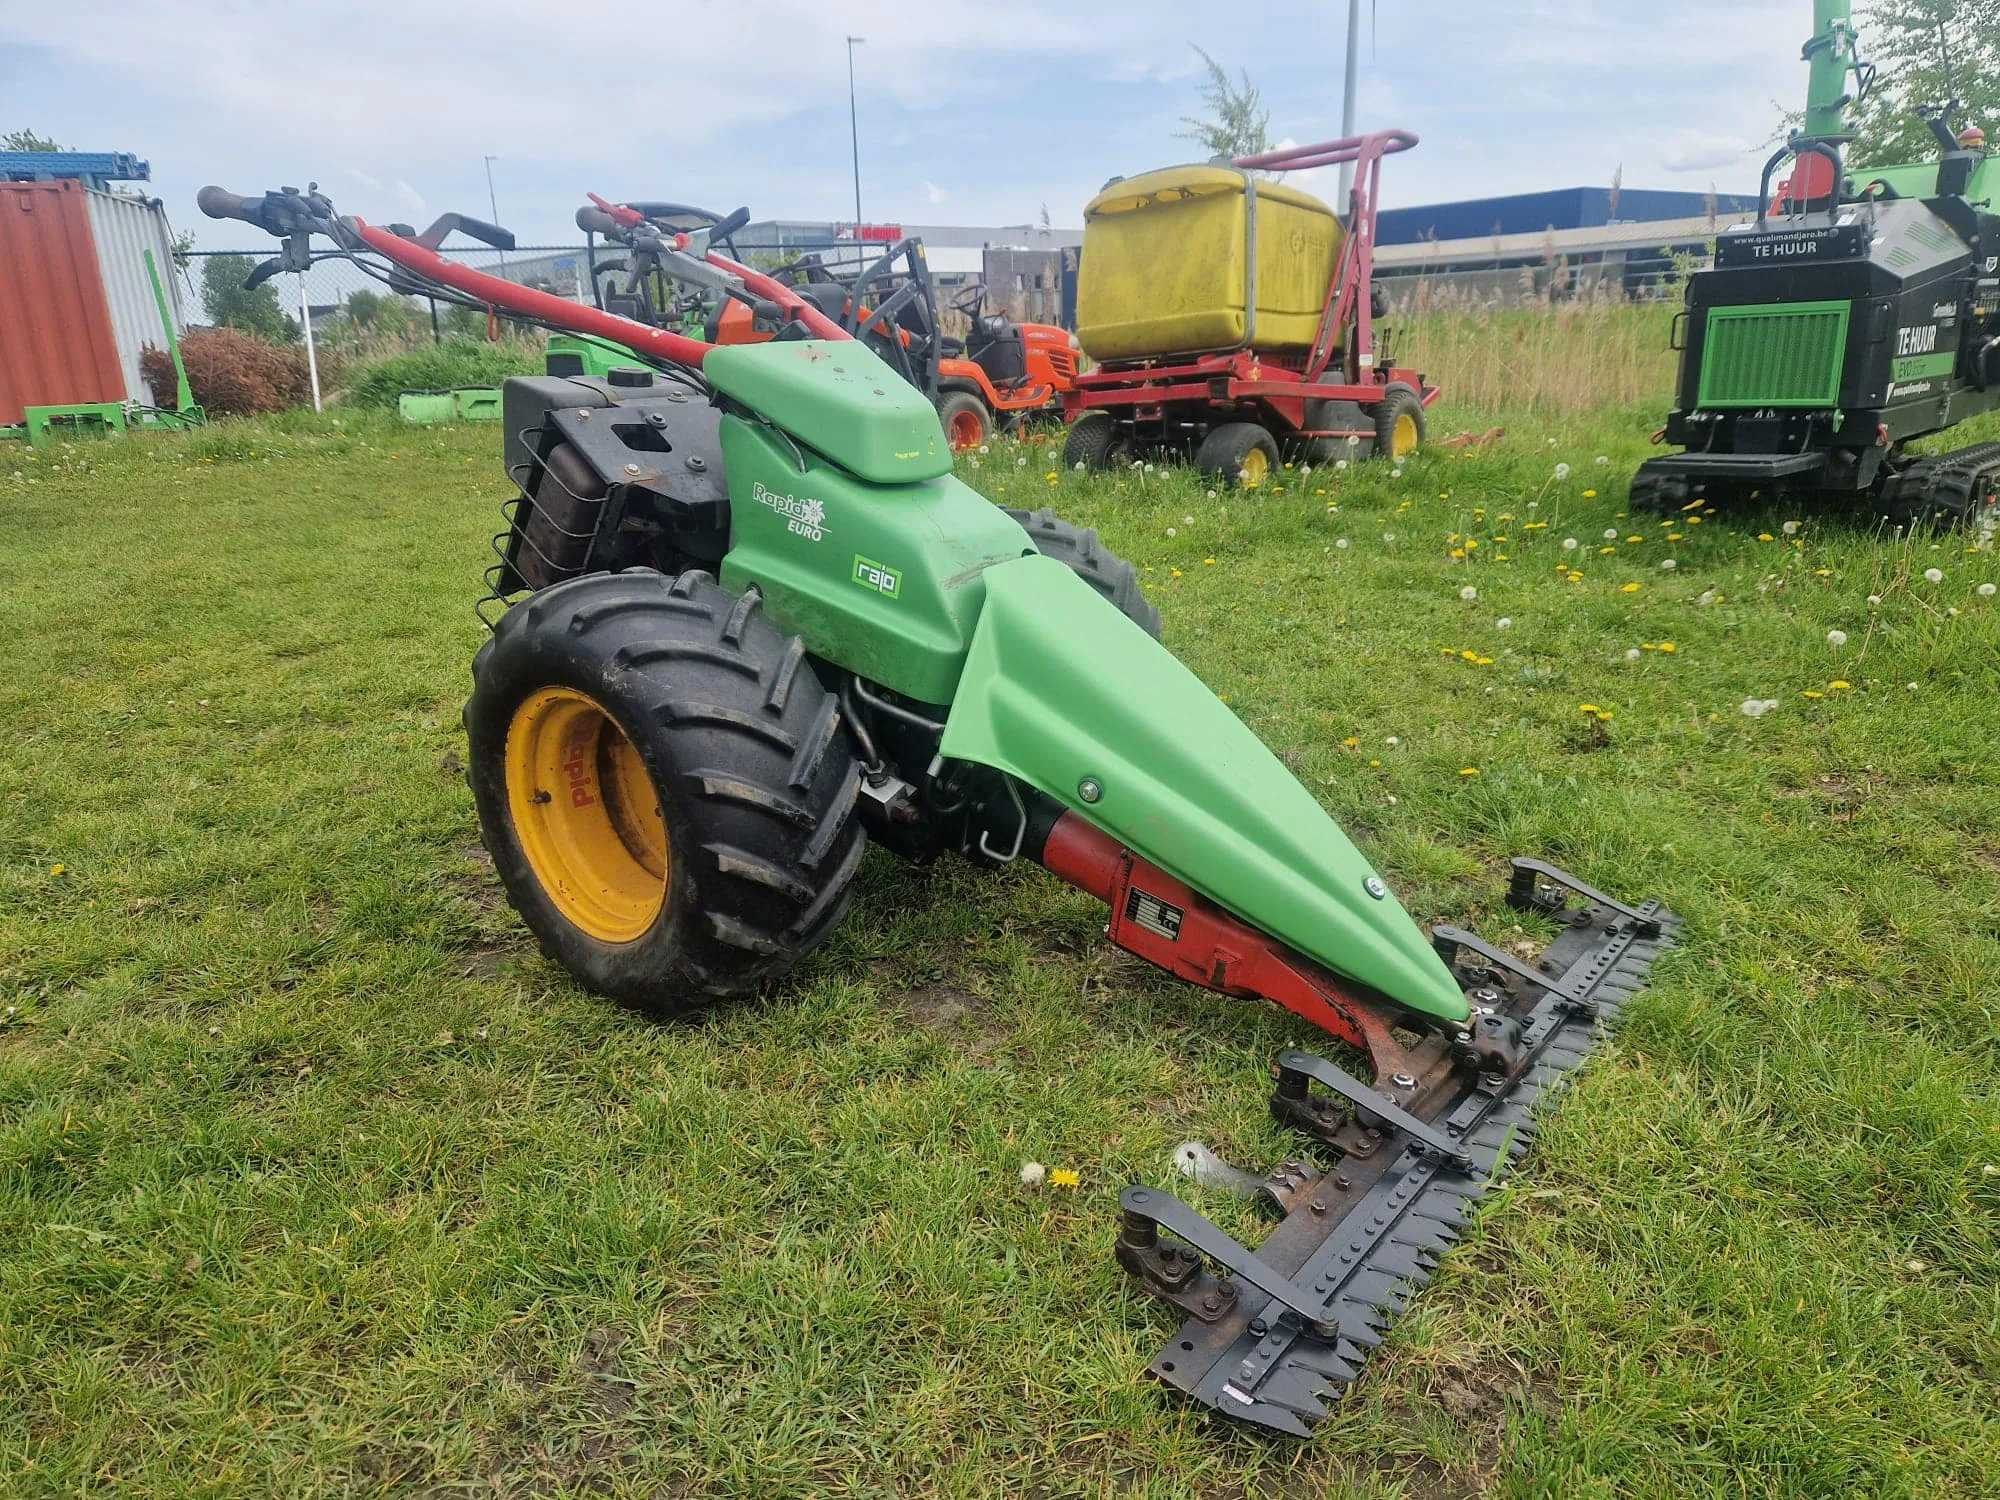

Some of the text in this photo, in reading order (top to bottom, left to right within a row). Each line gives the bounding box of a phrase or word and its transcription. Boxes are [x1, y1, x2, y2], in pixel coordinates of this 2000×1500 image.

[1734, 230, 1828, 244] www.qualimandjaro.be
[1753, 241, 1817, 257] TE HUUR
[1898, 325, 1937, 355] TE HUUR
[753, 482, 807, 517] Rapid
[788, 521, 822, 542] EURO
